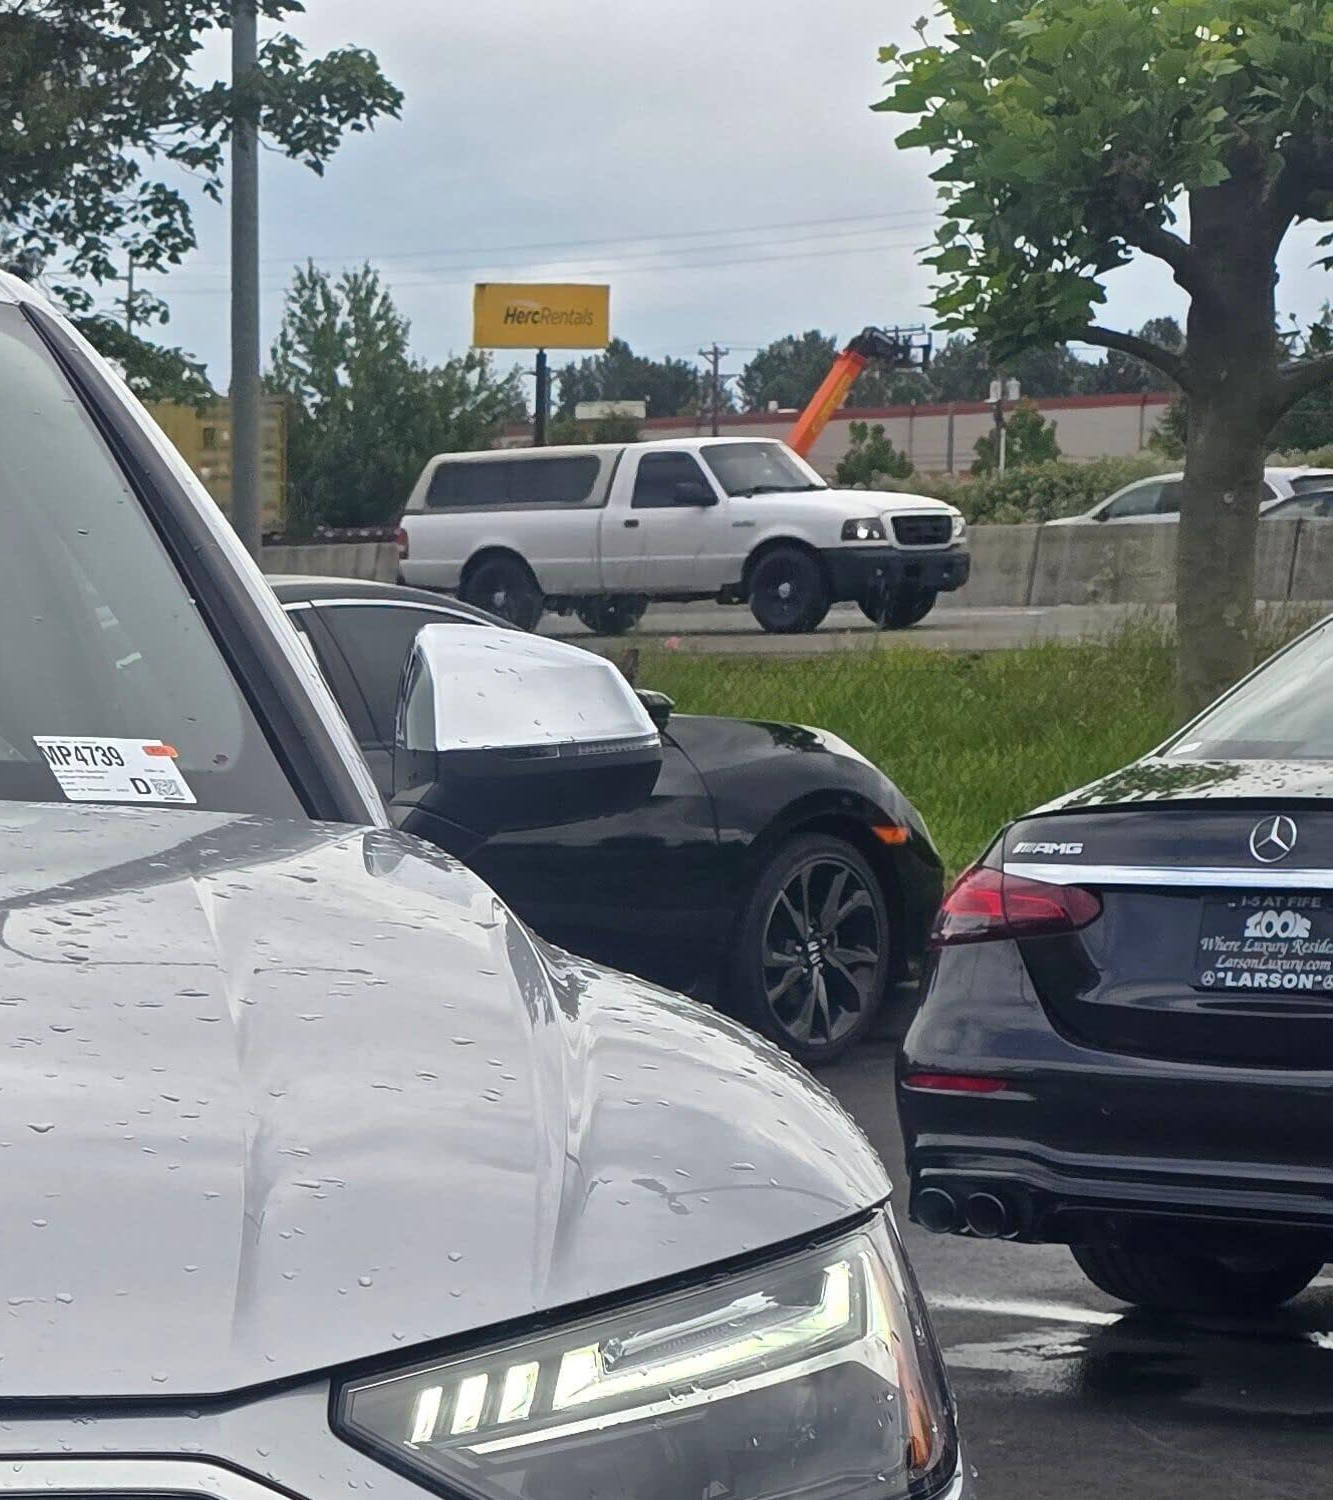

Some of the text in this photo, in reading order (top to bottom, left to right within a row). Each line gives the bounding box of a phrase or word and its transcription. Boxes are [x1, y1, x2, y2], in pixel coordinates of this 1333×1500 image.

[503, 305, 594, 326] HercRentals
[129, 777, 152, 795] D
[1200, 936, 1242, 952] Where
[1243, 939, 1289, 958] Luxury
[1215, 955, 1332, 973] LarsonLuxury.com
[1225, 971, 1314, 989] LARSON
